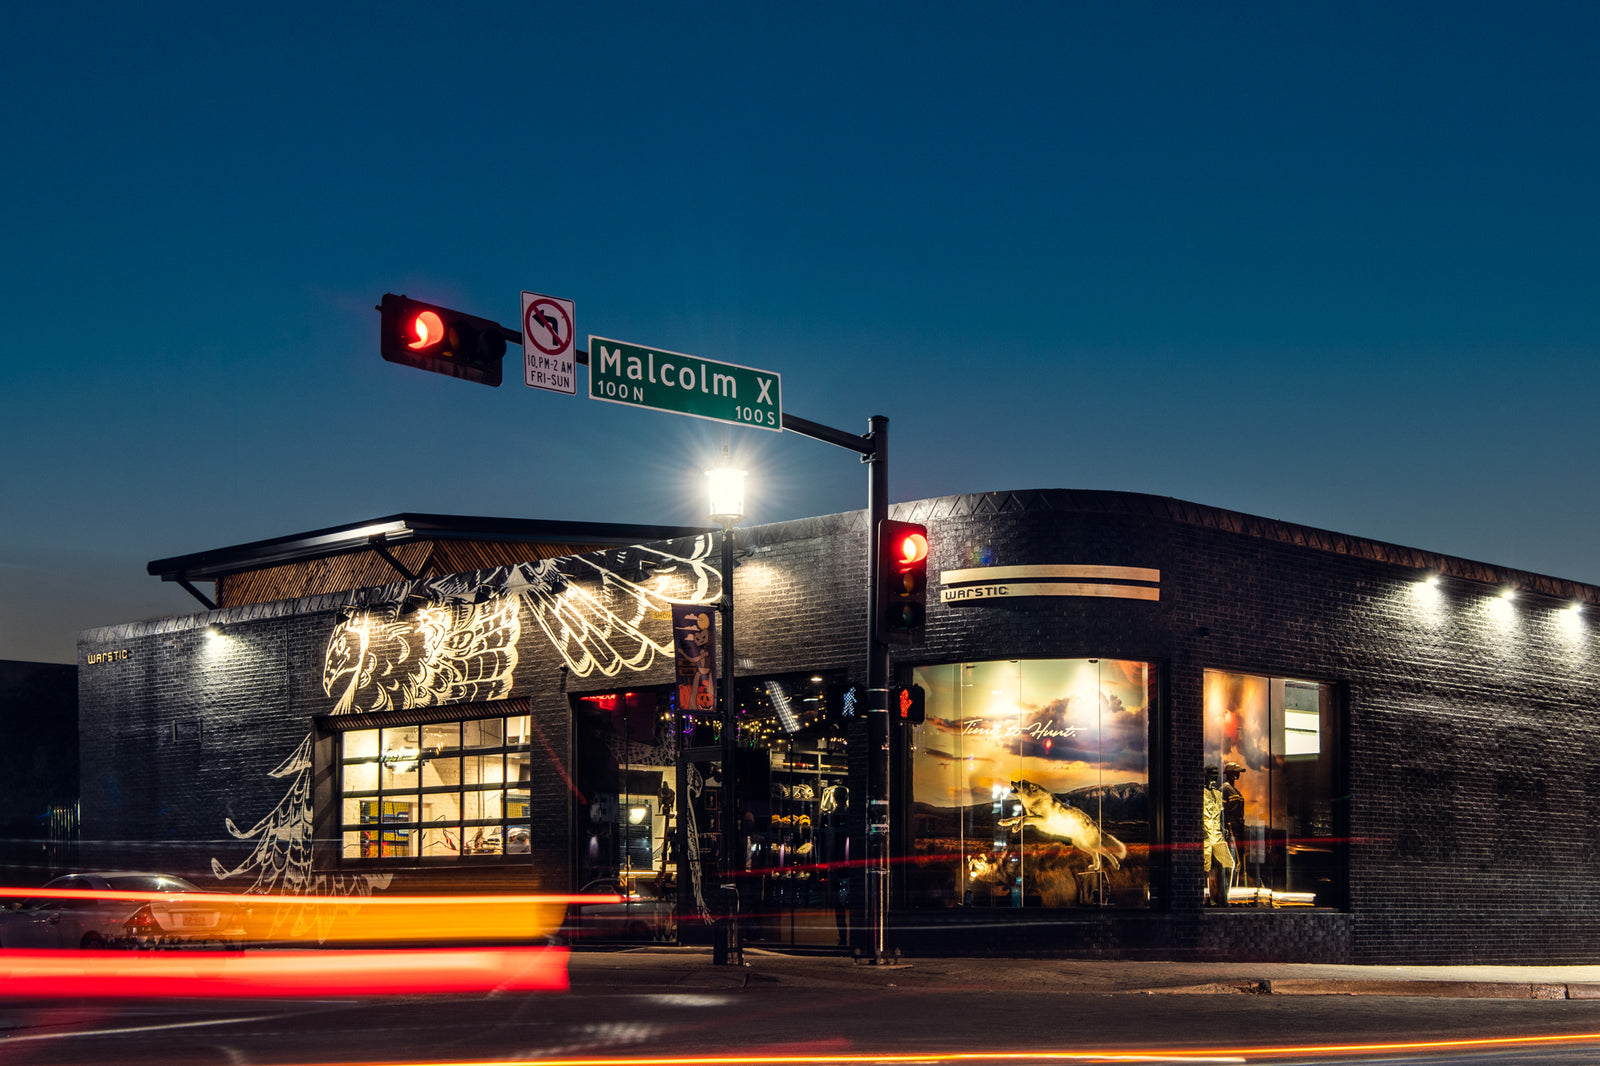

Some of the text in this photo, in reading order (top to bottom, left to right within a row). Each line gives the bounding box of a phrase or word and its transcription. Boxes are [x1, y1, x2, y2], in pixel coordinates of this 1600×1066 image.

[561, 361, 572, 374] AM
[600, 346, 773, 406] Malcolm X
[531, 370, 569, 388] FRI-SUN
[598, 380, 643, 402] 100 N
[735, 405, 775, 426] 100 S
[962, 719, 1000, 735] Time
[1006, 726, 1023, 737] to
